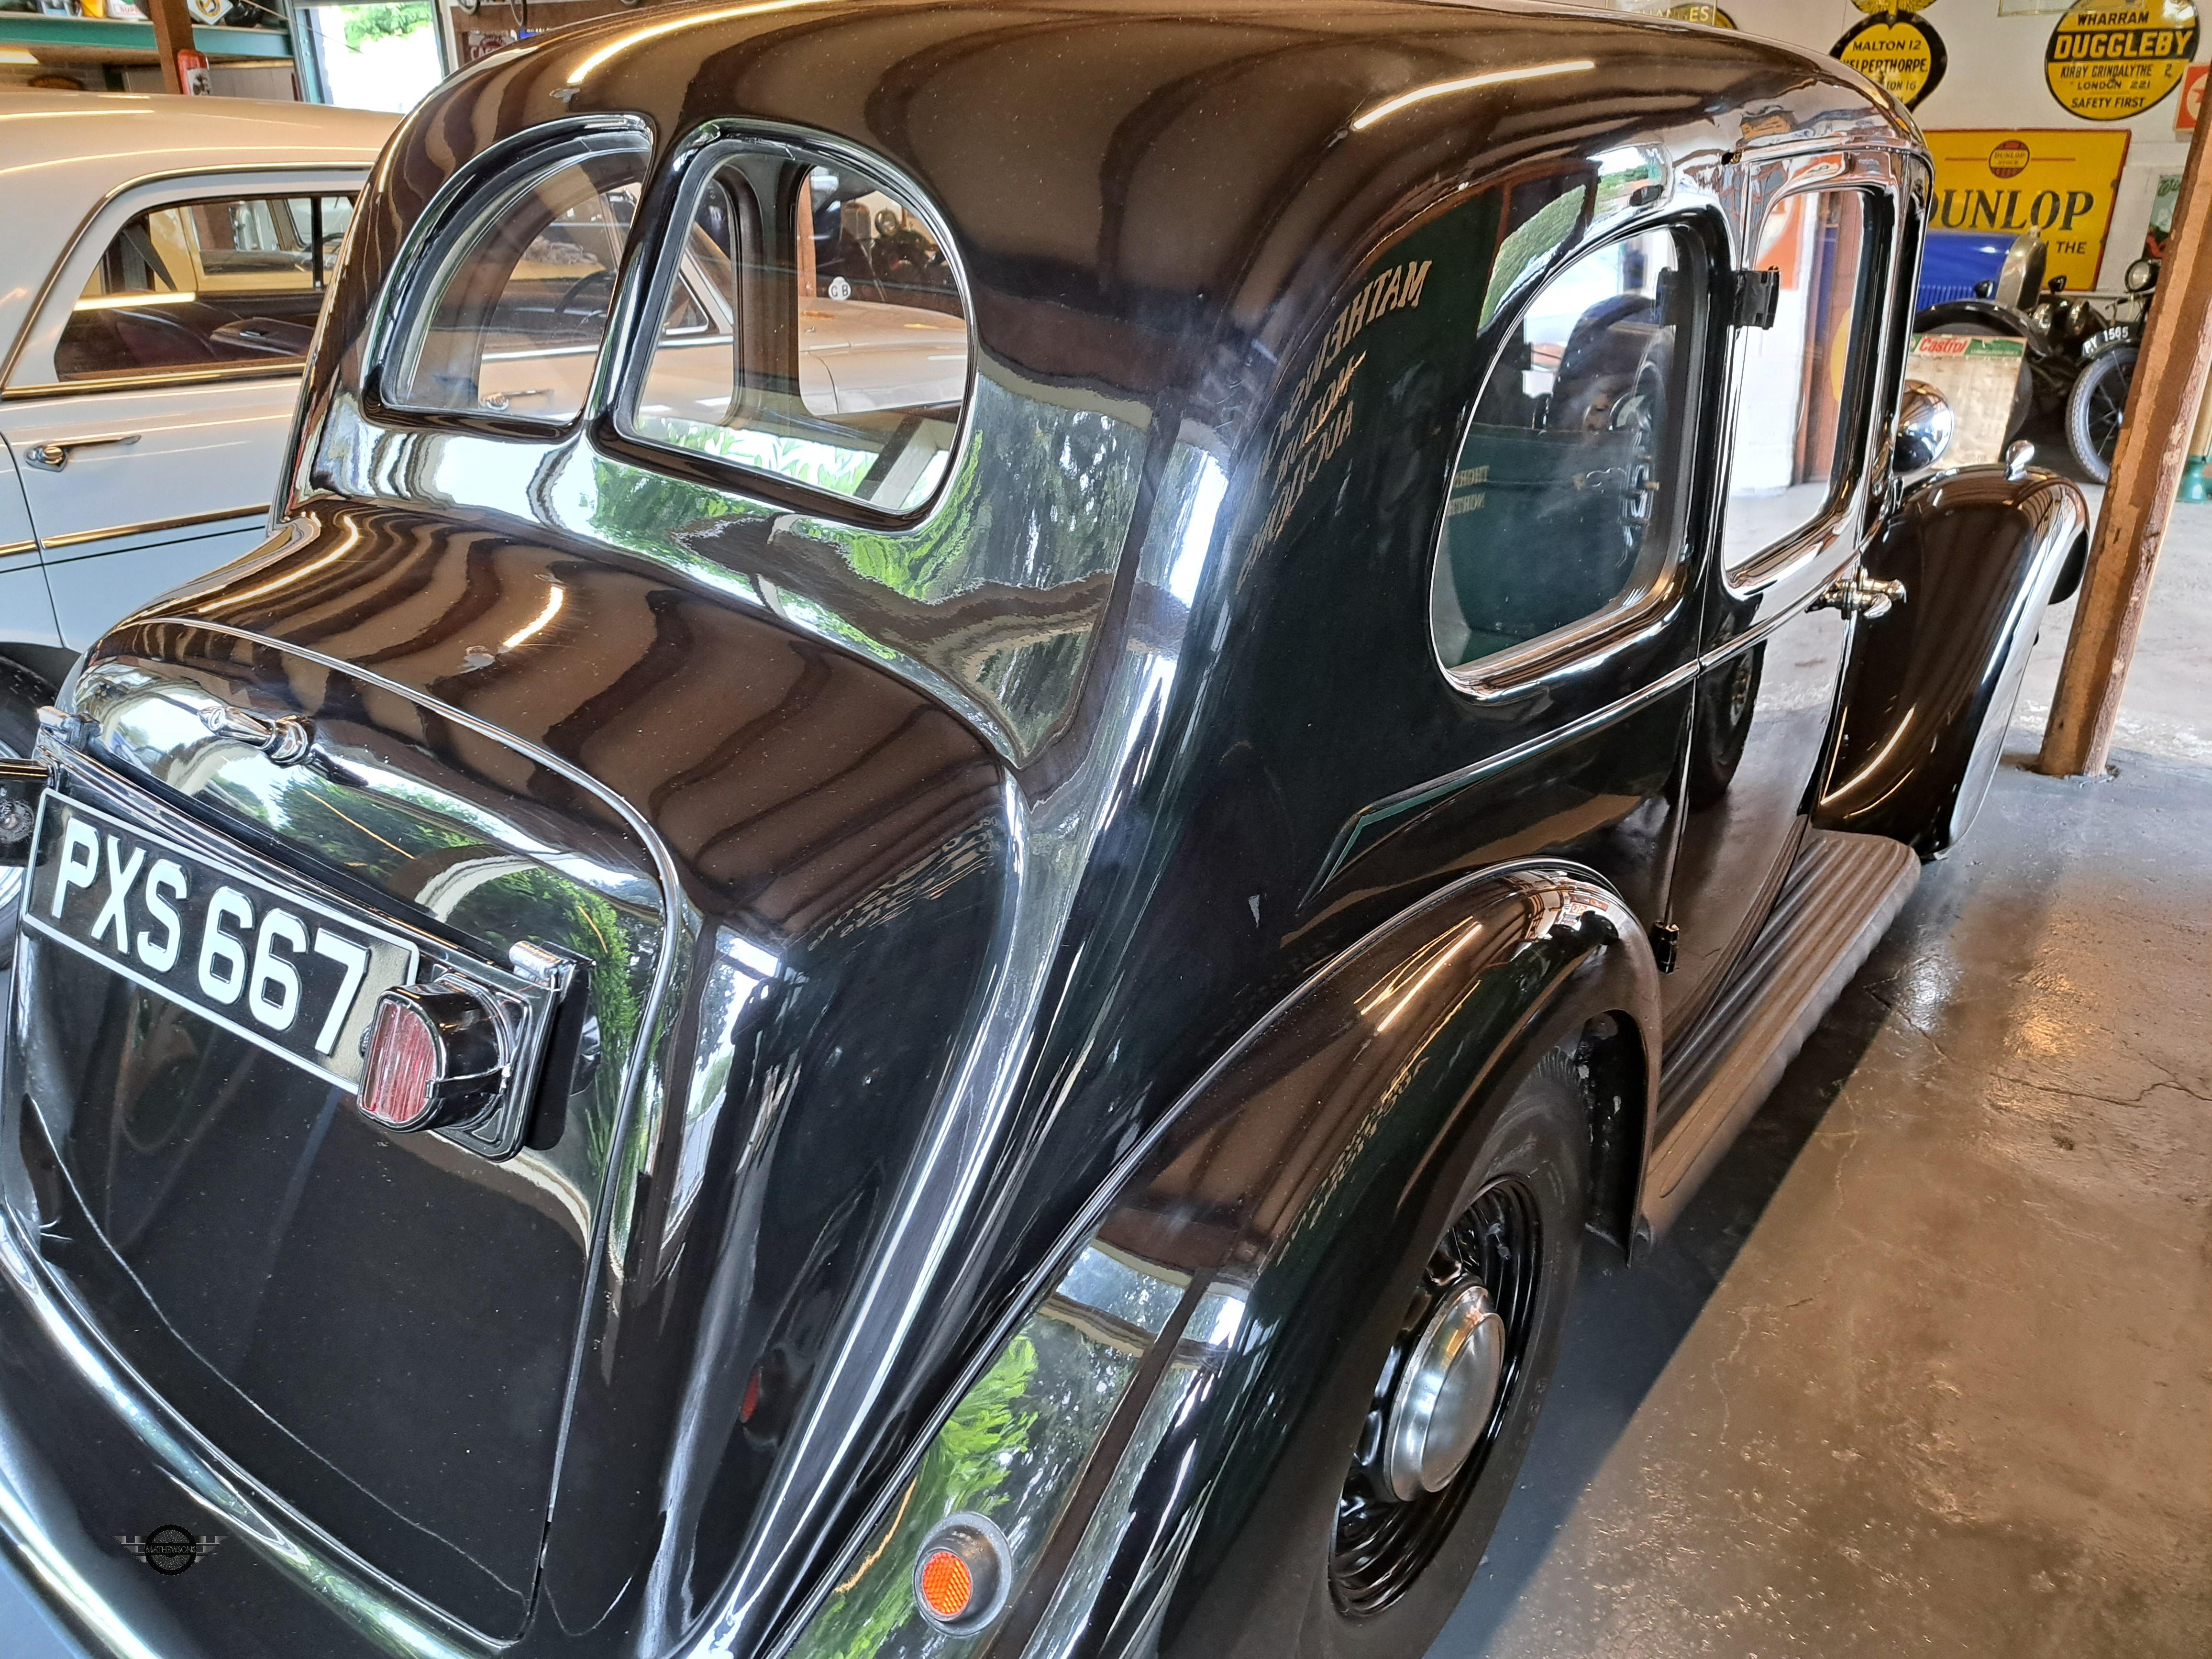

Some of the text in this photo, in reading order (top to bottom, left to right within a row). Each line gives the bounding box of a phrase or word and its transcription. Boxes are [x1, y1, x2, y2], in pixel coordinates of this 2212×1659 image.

[2078, 11, 2149, 26] WHARRAM
[1853, 40, 1921, 51] MALTON 12
[2054, 30, 2193, 59] DUGGLEBY
[2060, 65, 2089, 78] KIRBY
[2077, 80, 2122, 90] LONDON
[2071, 96, 2146, 109] SAFETY FIRST
[2057, 241, 2087, 254] THE
[1919, 338, 1968, 353] Castrol
[51, 816, 371, 1057] PXS 667
